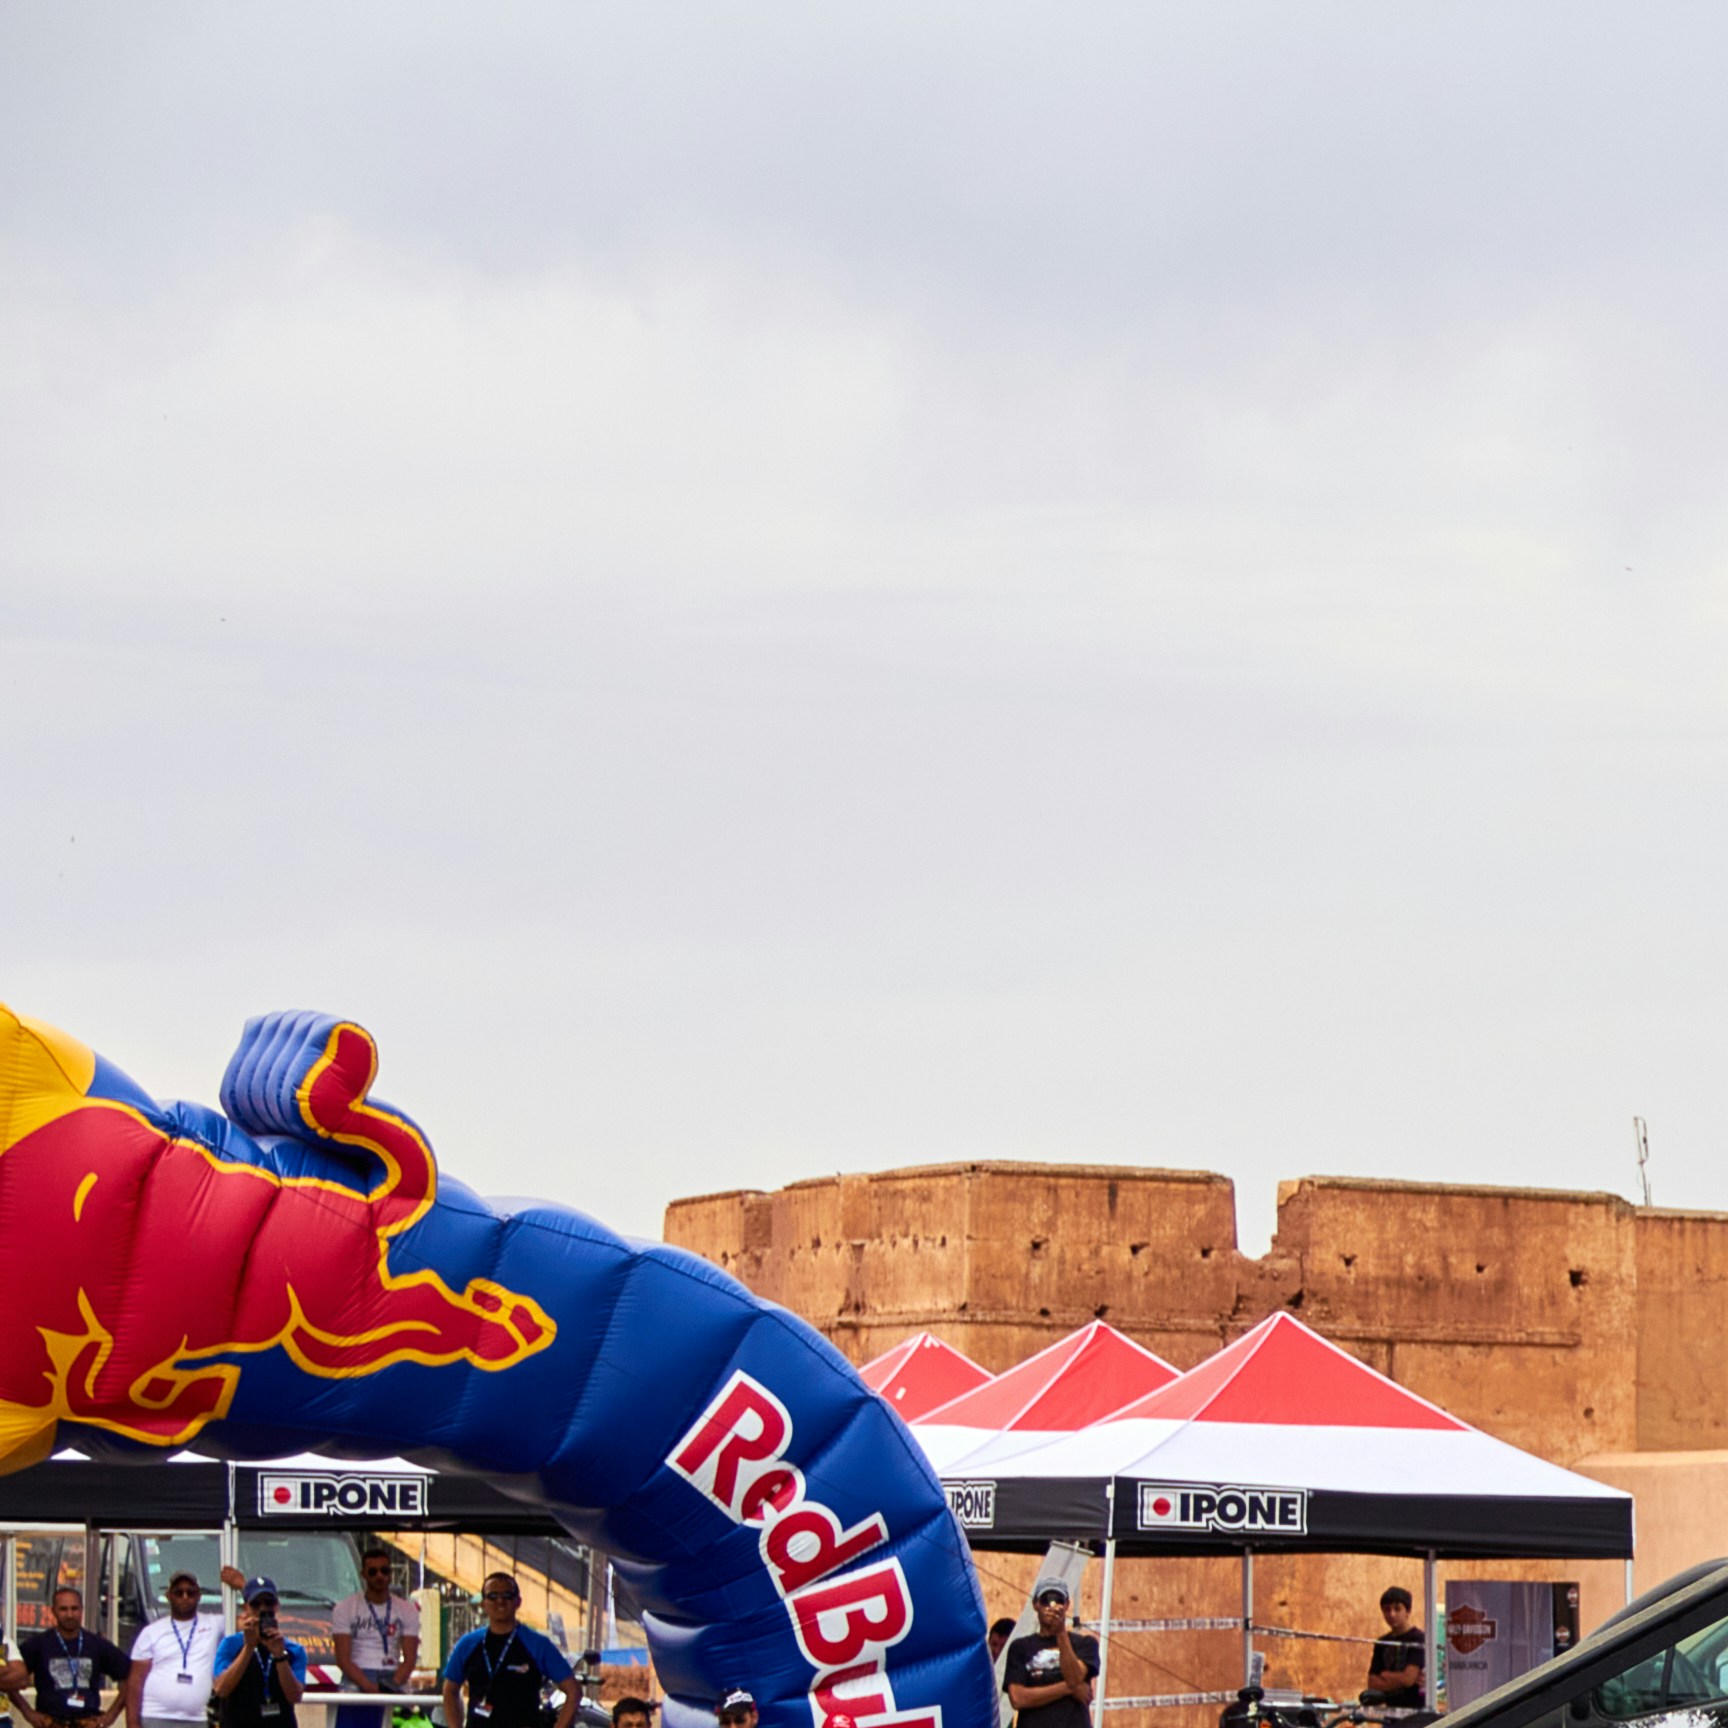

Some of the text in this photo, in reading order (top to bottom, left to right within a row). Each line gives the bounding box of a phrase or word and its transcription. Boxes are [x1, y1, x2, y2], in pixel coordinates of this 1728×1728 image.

[300, 1481, 419, 1511] IPONE
[670, 1374, 887, 1596] Red
[1179, 1492, 1299, 1527] IPONE
